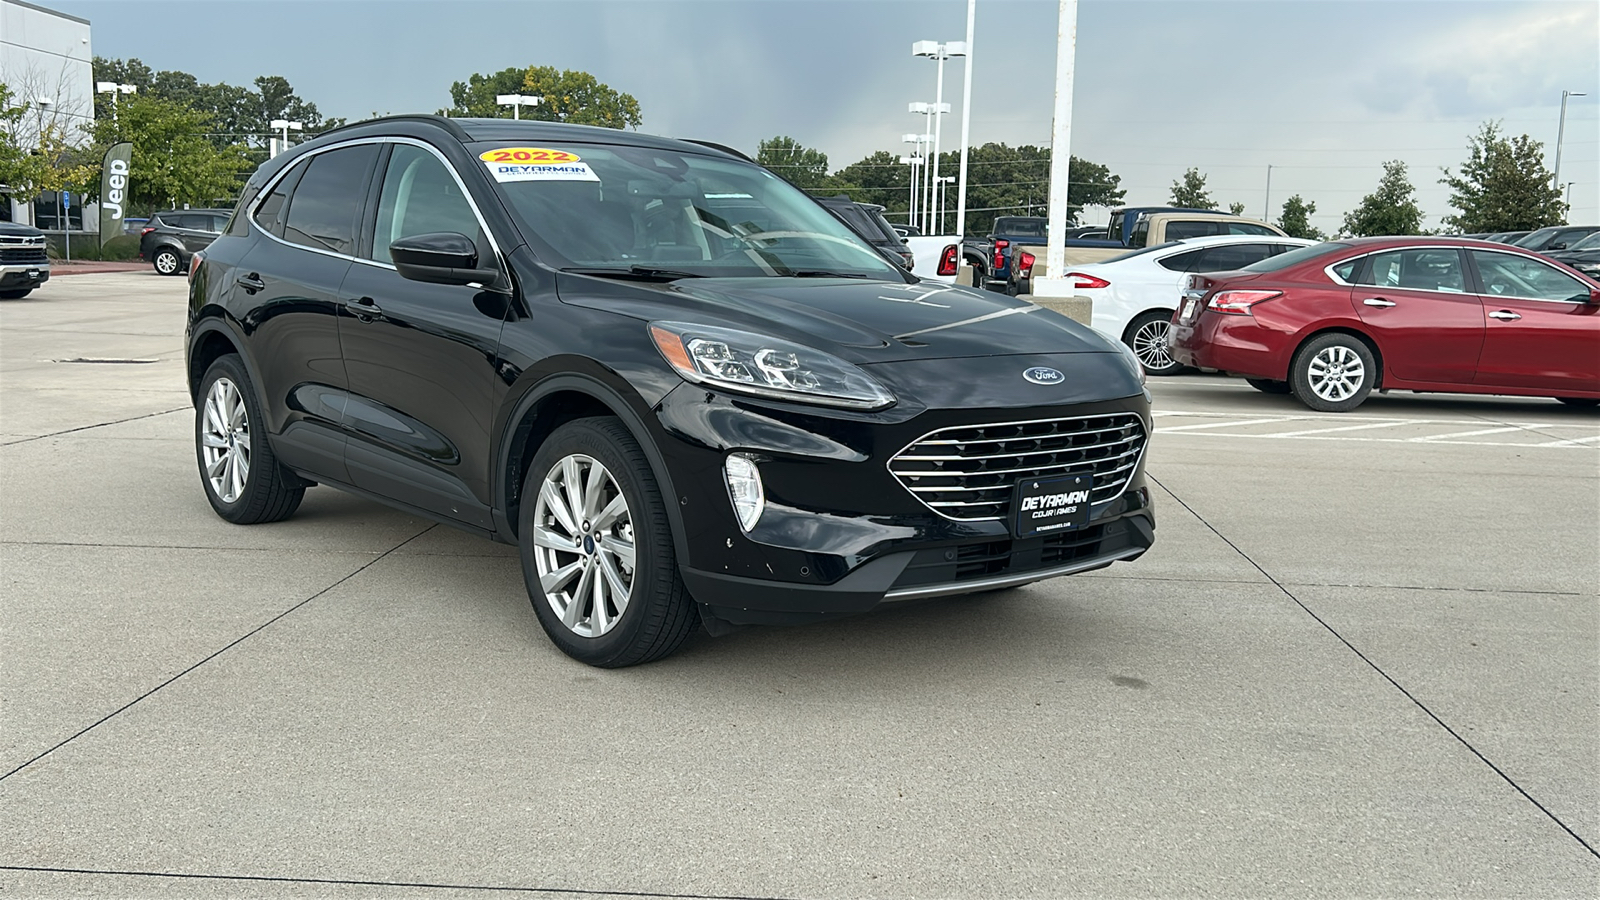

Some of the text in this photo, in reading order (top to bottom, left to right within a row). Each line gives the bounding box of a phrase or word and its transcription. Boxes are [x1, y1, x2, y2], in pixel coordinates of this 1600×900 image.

[494, 151, 570, 162] 2022
[103, 159, 129, 220] Jeep
[1034, 369, 1057, 379] Ford
[1021, 490, 1089, 511] DEYARMAN
[1057, 506, 1077, 515] AMES
